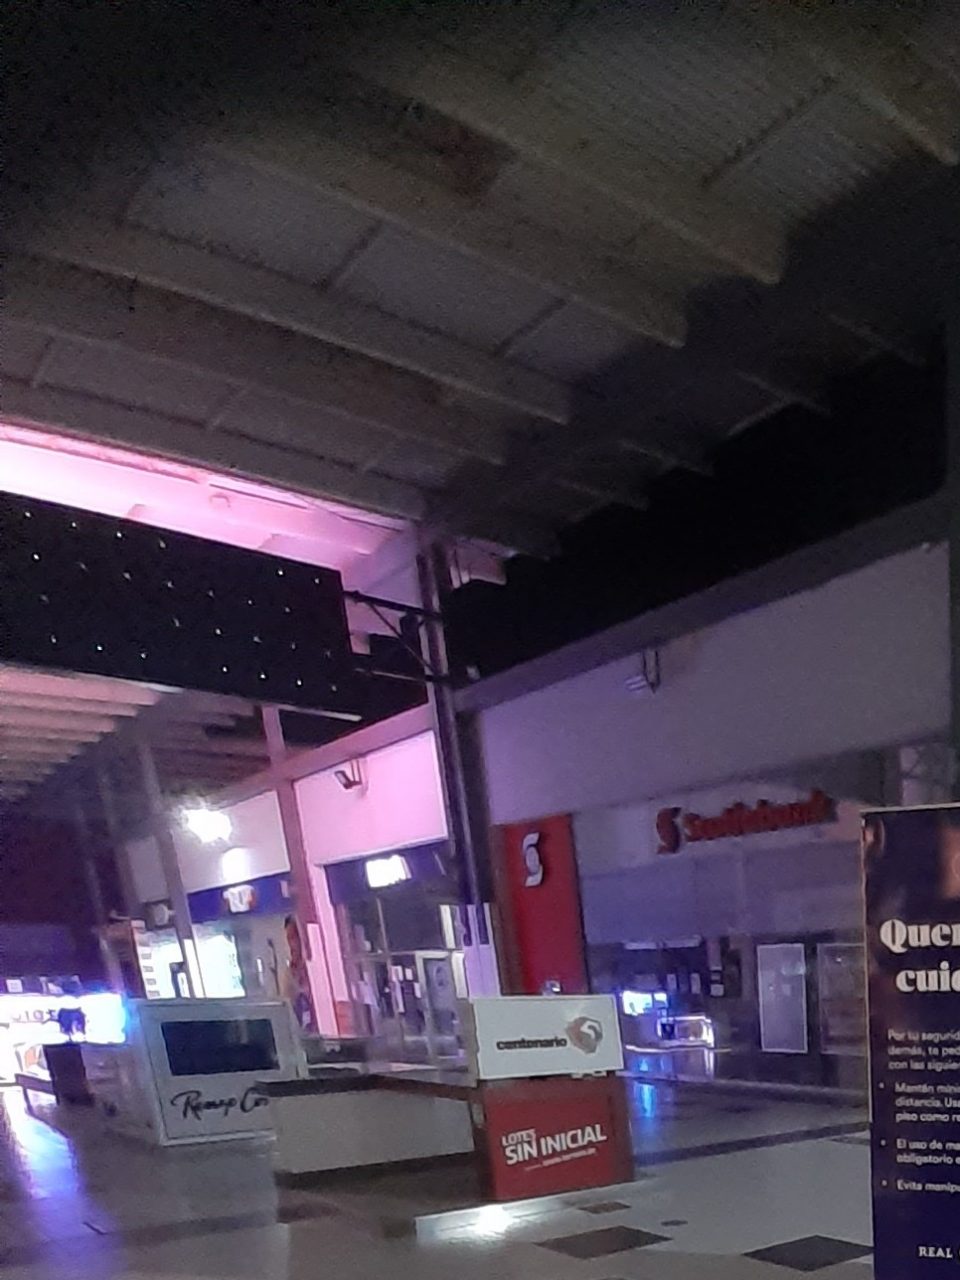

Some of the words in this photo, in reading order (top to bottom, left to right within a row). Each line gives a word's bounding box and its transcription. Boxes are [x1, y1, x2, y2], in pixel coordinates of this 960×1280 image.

[888, 1029, 907, 1041] Por
[908, 1030, 919, 1041] tu
[496, 1036, 568, 1051] centenario
[928, 1046, 939, 1056] te
[888, 1061, 908, 1070] con
[910, 1060, 925, 1070] las
[895, 1082, 935, 1094] Mantén
[895, 1097, 943, 1108] distancia.
[896, 1111, 918, 1123] piso
[920, 1112, 950, 1122] como
[505, 1138, 538, 1166] SIN
[540, 1124, 608, 1156] INICIAL
[897, 1139, 907, 1149] El
[908, 1140, 927, 1150] uso
[929, 1140, 943, 1150] de
[897, 1153, 953, 1166] obligatorio
[897, 1179, 923, 1191] Evita
[918, 1246, 953, 1259] REAL
